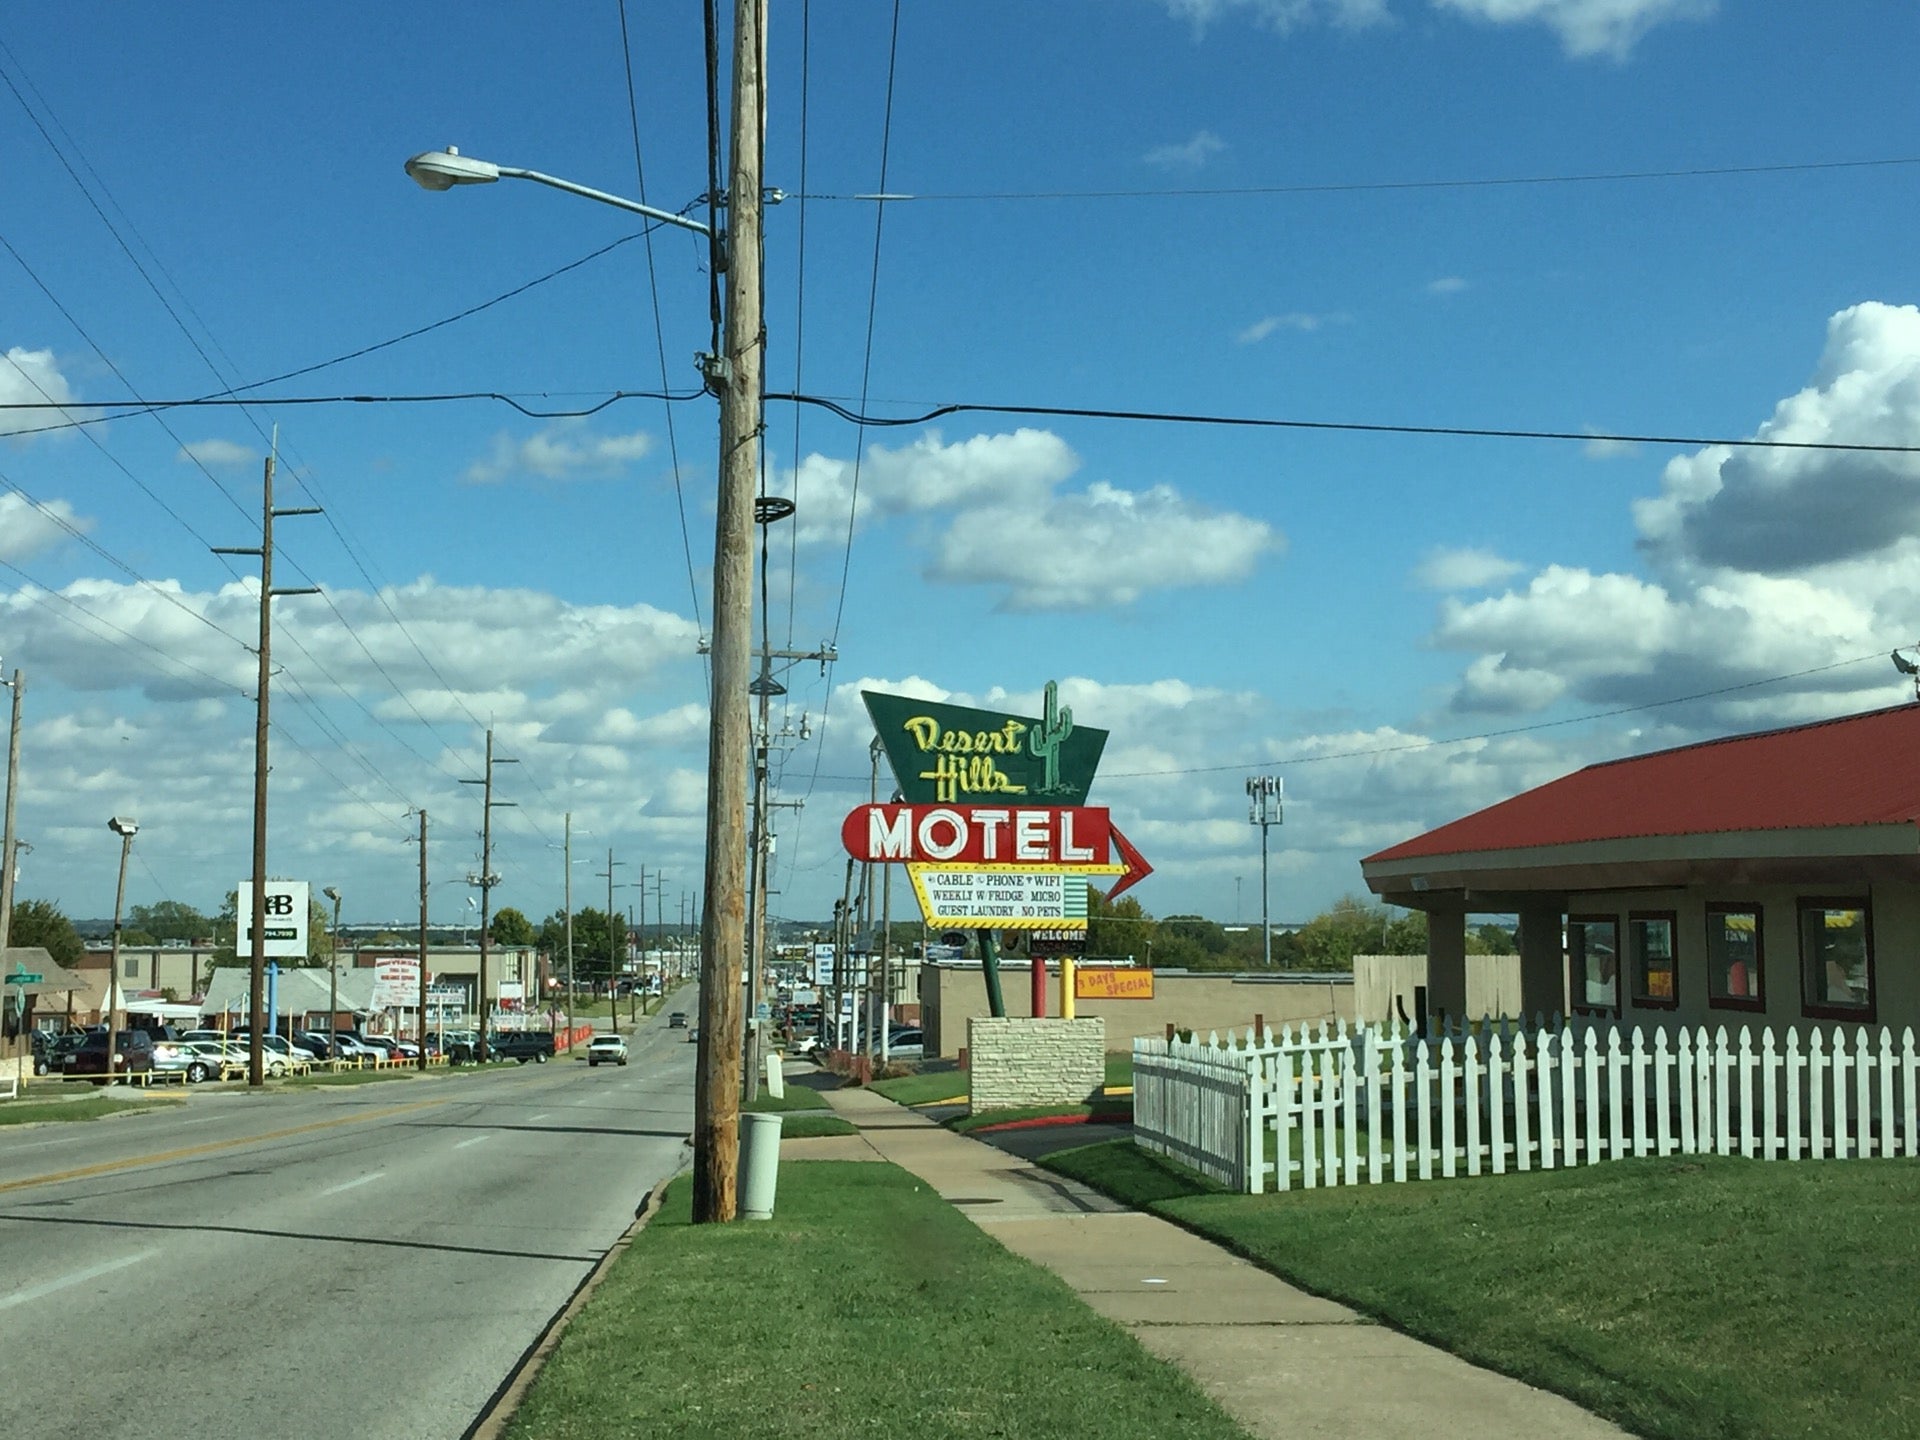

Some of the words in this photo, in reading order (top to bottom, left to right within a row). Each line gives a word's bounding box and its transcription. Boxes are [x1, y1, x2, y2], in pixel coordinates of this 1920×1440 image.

[904, 717, 1027, 753] Desert
[920, 754, 1028, 803] Hills
[869, 808, 1094, 861] MOTEL
[937, 874, 974, 886] CABLE
[986, 875, 1024, 887] PHONE
[1035, 875, 1061, 887] WIFI
[932, 889, 973, 901] WEEKLY
[1031, 891, 1061, 903] MICRO
[937, 905, 970, 917] GUEST
[971, 905, 1014, 917] LAUNDRY
[1021, 906, 1035, 917] NO
[1037, 906, 1061, 918] PETS
[1031, 930, 1086, 940] WELCOME
[1088, 972, 1116, 986] DAYS
[1106, 978, 1151, 996] SPECIAL
